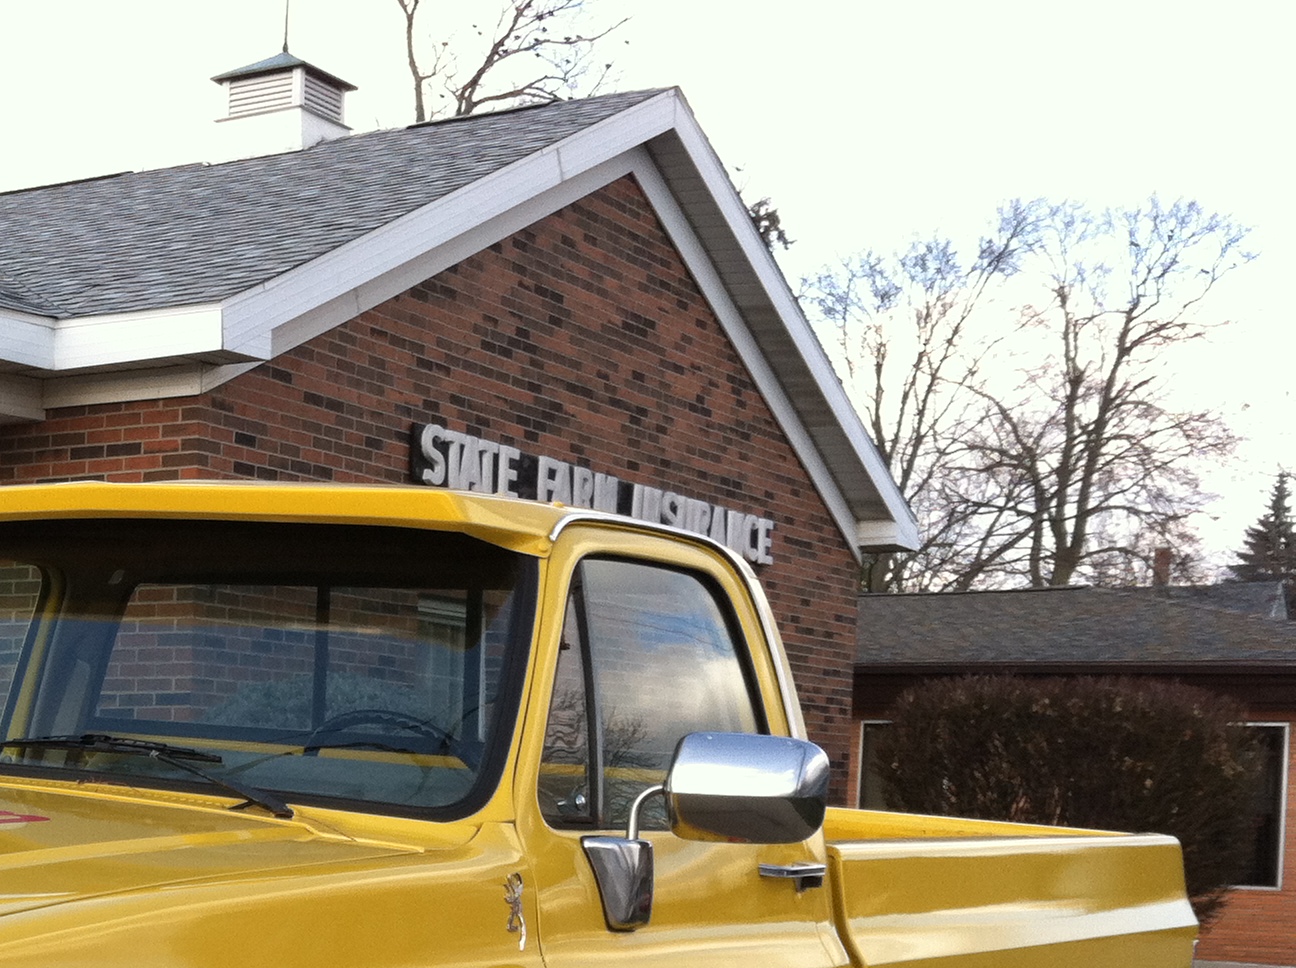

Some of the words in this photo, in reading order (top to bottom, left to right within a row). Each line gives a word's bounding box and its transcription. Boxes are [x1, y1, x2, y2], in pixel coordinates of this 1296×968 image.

[420, 423, 522, 500] STATE
[537, 455, 619, 514] FARM
[631, 483, 775, 566] INSURANCE
